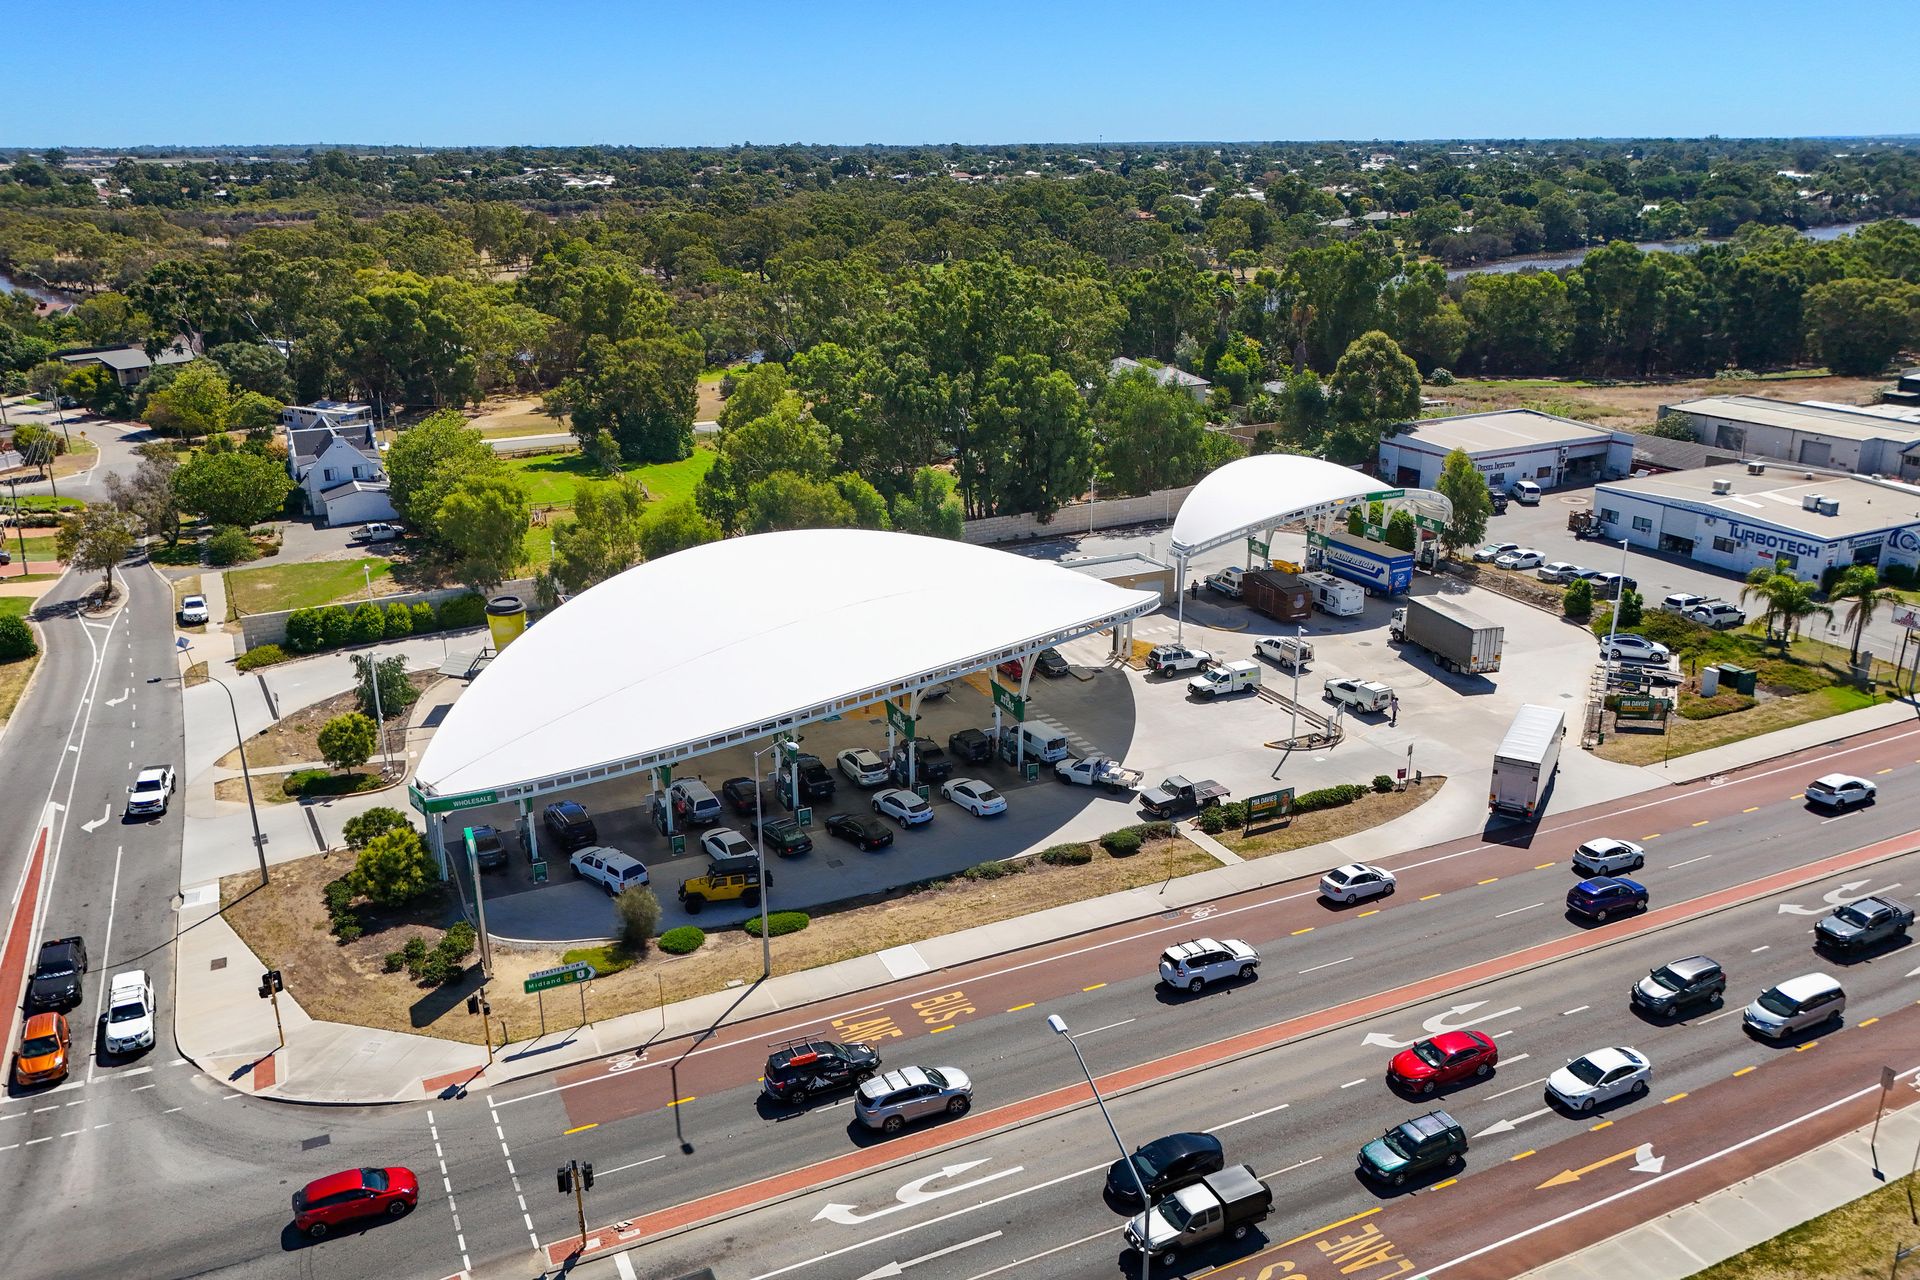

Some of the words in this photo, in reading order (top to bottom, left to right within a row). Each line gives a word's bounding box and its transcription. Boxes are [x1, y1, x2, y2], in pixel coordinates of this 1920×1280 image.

[1728, 521, 1820, 559] TURBOTECH
[452, 795, 492, 807] WHOLESALE
[528, 977, 561, 990] Midland
[541, 966, 570, 976] EASTERN
[571, 961, 585, 969] HWY
[911, 991, 977, 1024] BUS
[831, 1007, 904, 1044] LANE
[1315, 1222, 1416, 1280] LANE
